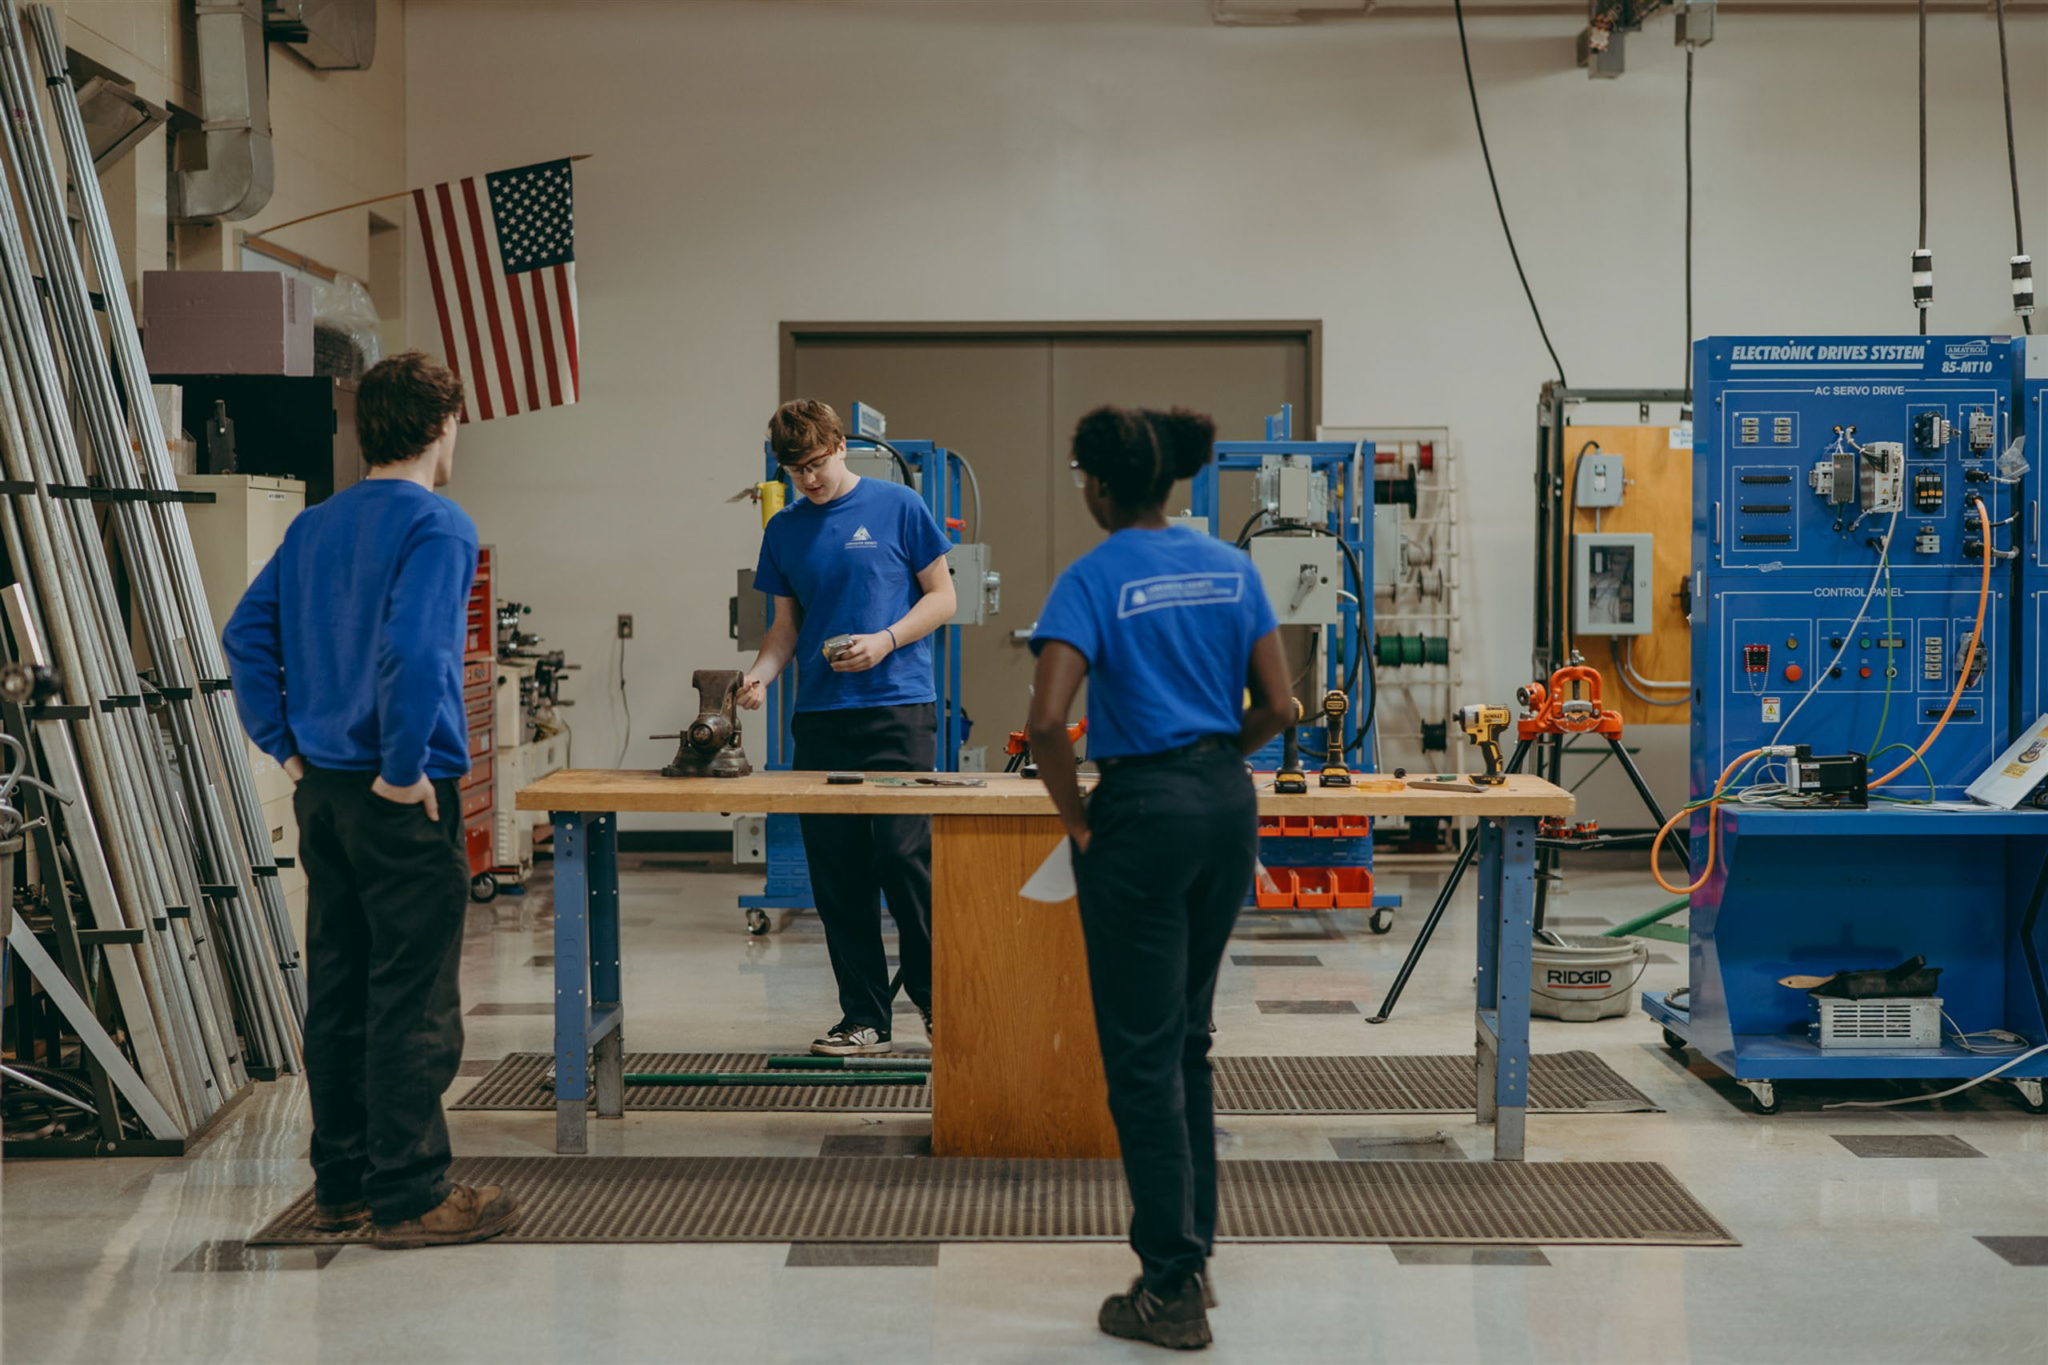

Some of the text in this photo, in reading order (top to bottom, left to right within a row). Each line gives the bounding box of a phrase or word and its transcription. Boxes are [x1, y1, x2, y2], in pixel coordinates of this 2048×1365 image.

[1732, 345, 1925, 360] ELECTRONIC DRIVES SYSTEM
[1947, 346, 1986, 354] AMATROL
[1941, 361, 1993, 374] 85-MT10
[1814, 385, 1905, 396] AC SERVO DRIVE
[1814, 587, 1867, 597] CONTROL
[1547, 969, 1612, 985] RIDGID
